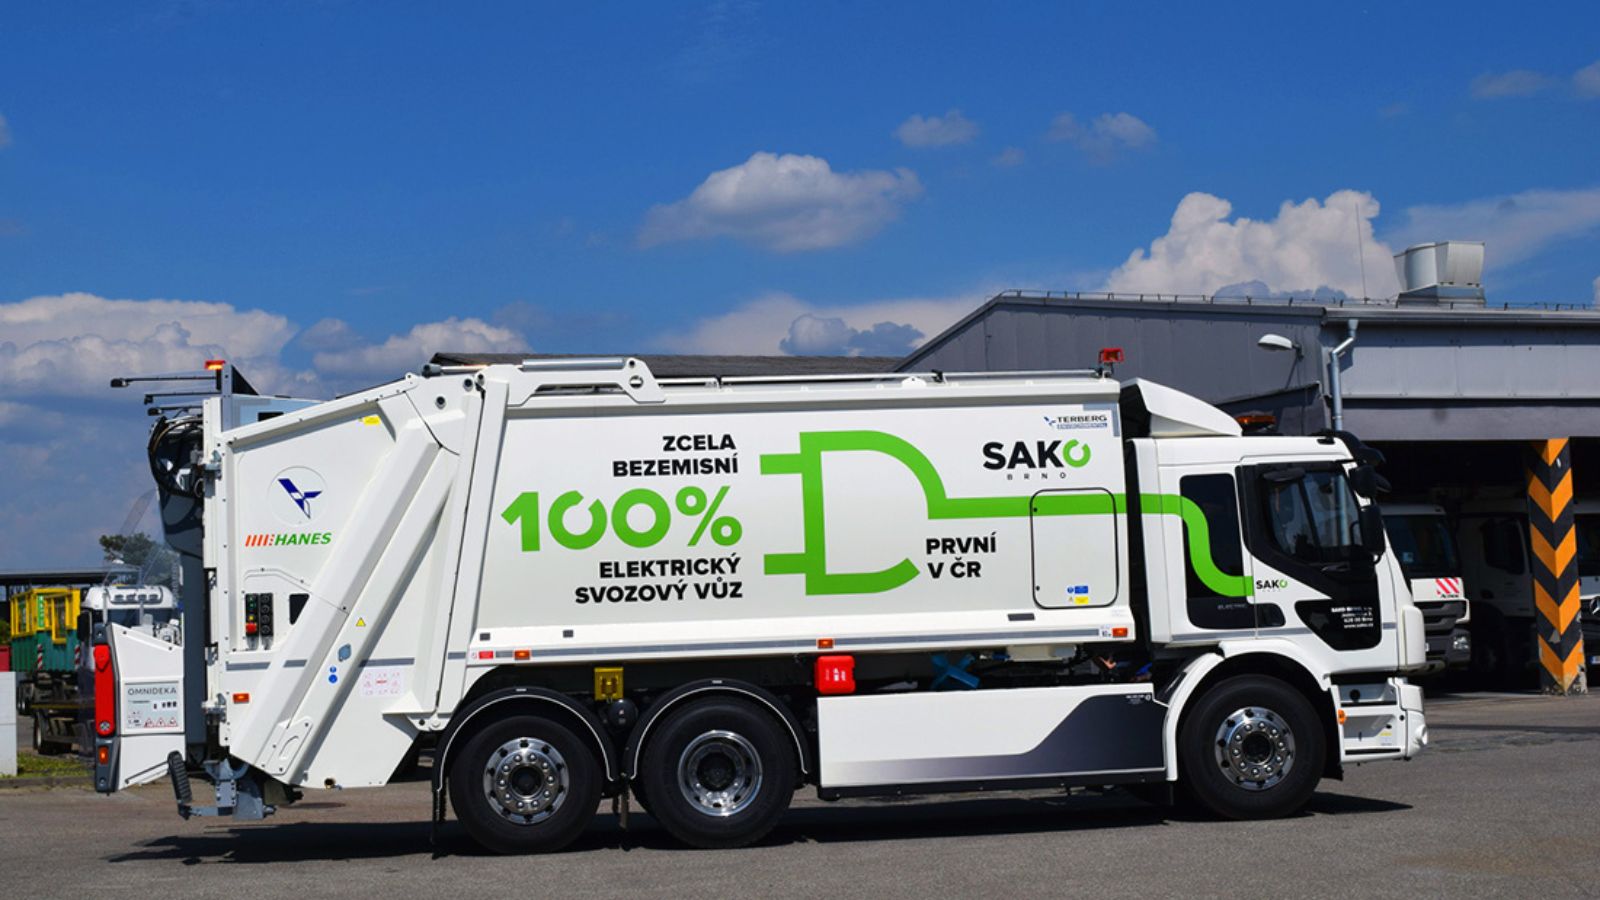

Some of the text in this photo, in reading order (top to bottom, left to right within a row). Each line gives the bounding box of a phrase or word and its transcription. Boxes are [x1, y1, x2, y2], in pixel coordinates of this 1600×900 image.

[1057, 415, 1107, 423] TERBERG
[662, 434, 736, 452] ZCELA
[612, 453, 738, 477] BEZEMISNÍ
[982, 439, 1091, 470] SAKO
[501, 486, 742, 552] 100%
[274, 532, 332, 546] HANES
[926, 532, 996, 554] PRVNÍ
[599, 553, 741, 578] ELEKTRICKÝ
[927, 557, 981, 579] V ČR
[575, 577, 743, 604] SVOZOVÝ VŮZ
[1256, 579, 1288, 590] SAKO
[127, 687, 177, 695] OMNIDEKA
